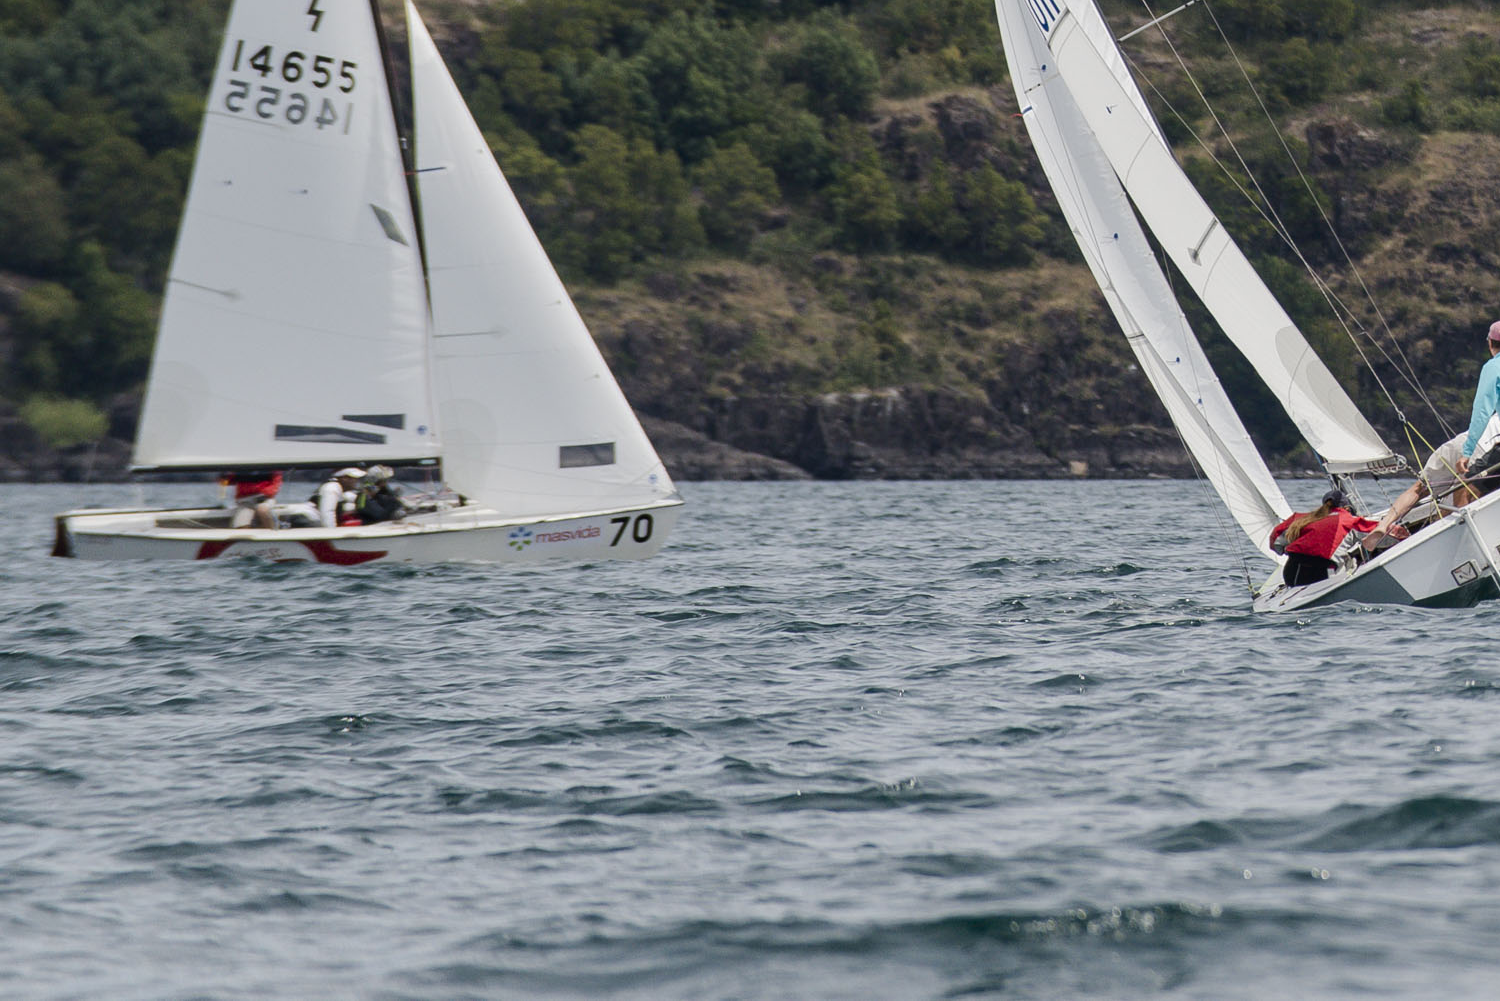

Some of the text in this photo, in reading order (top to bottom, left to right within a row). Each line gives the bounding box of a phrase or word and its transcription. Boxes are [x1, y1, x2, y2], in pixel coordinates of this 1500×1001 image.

[231, 40, 358, 94] 14655
[535, 525, 601, 544] masvida
[609, 513, 654, 547] 70
